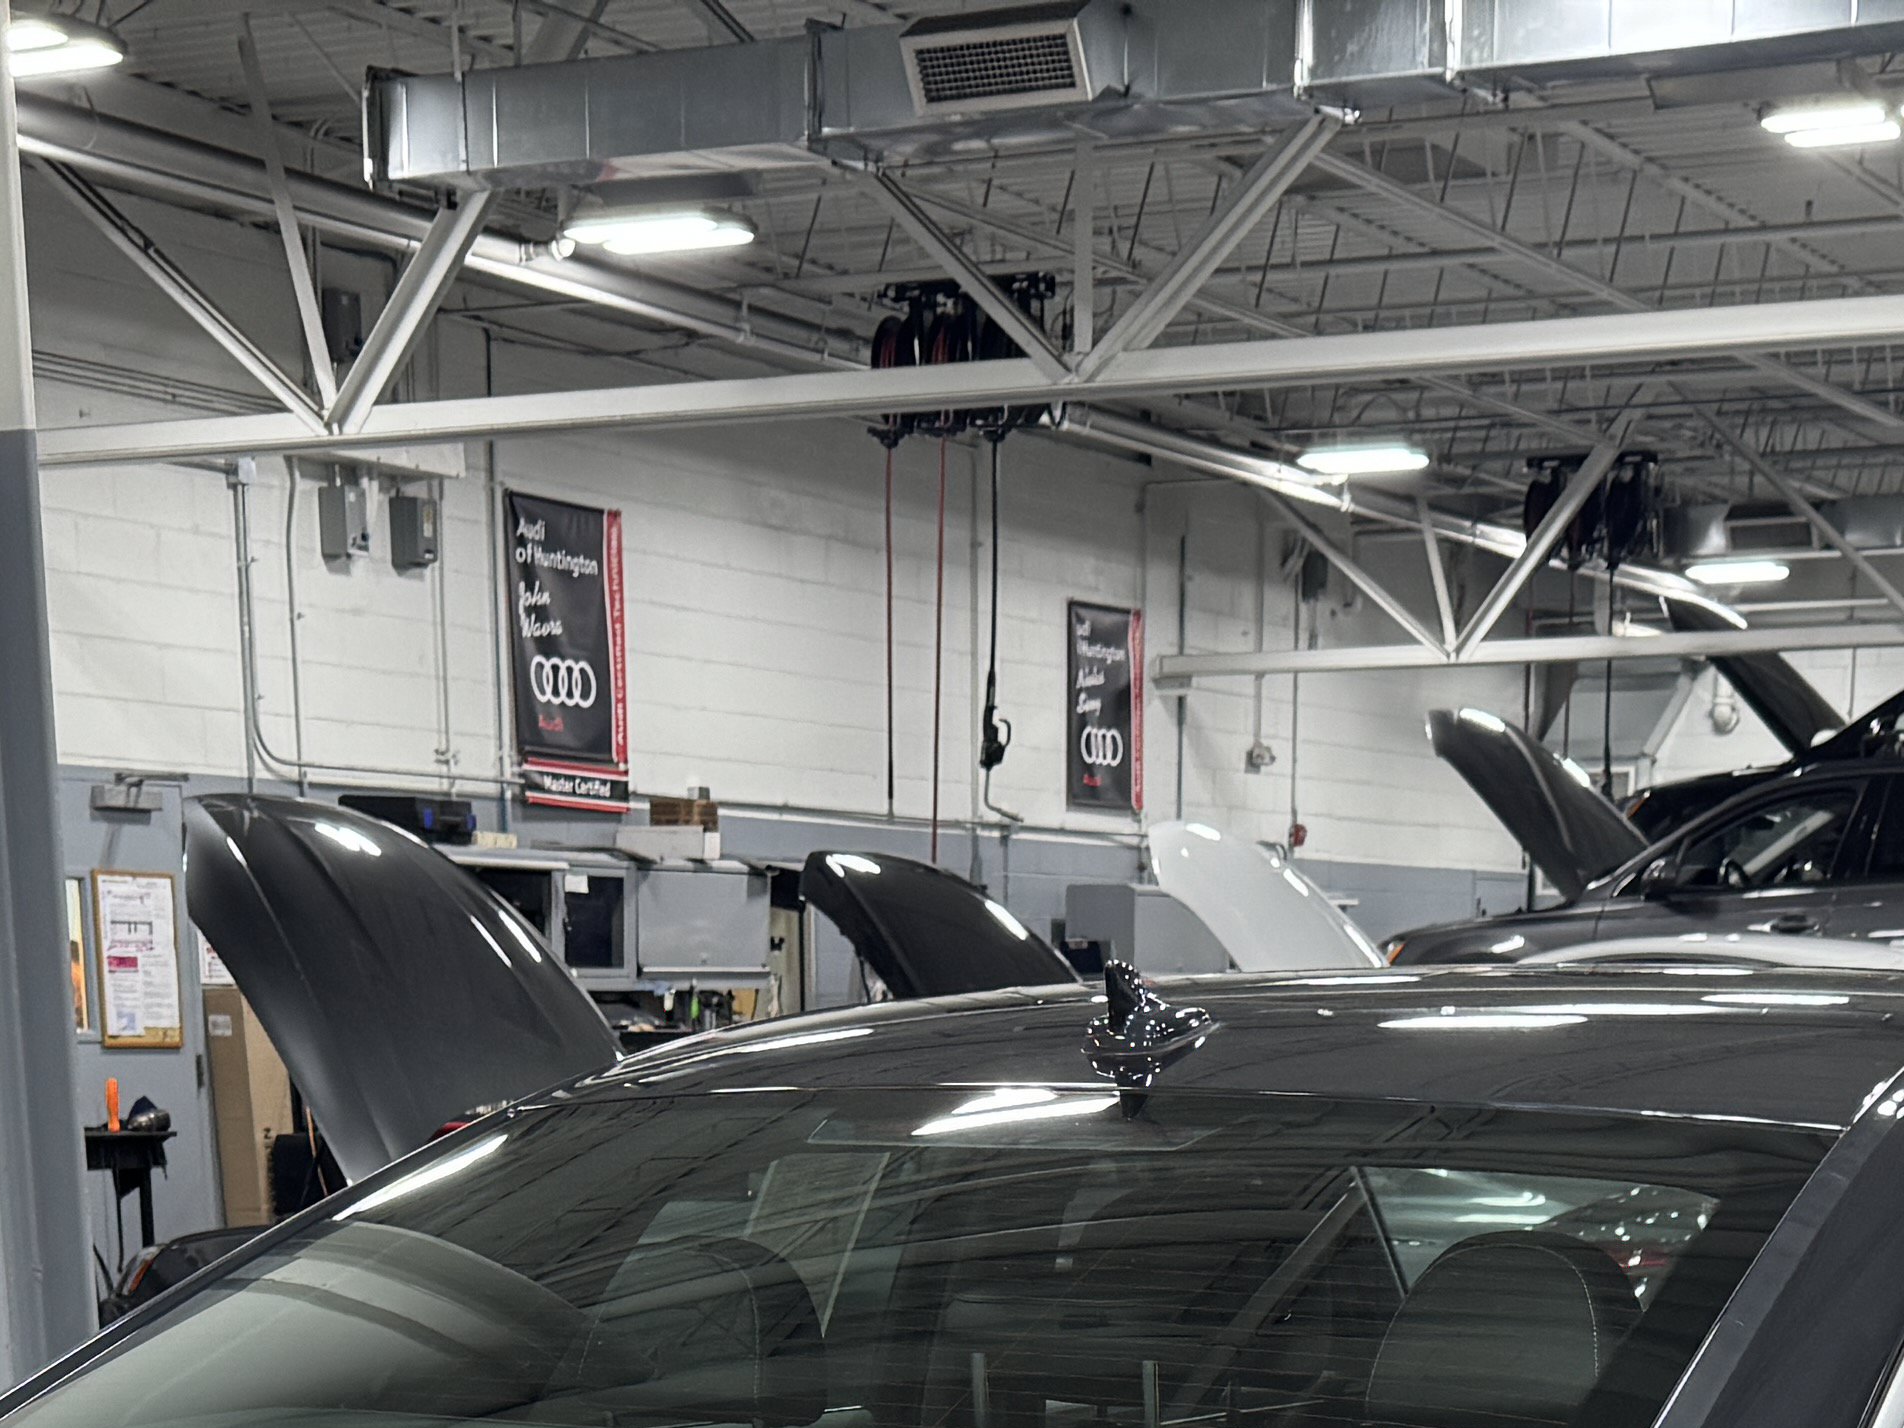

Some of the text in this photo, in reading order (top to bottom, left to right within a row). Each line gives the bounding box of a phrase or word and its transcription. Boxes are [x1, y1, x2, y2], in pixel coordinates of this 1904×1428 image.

[516, 517, 546, 541] Audi
[515, 542, 599, 578] of Huntington
